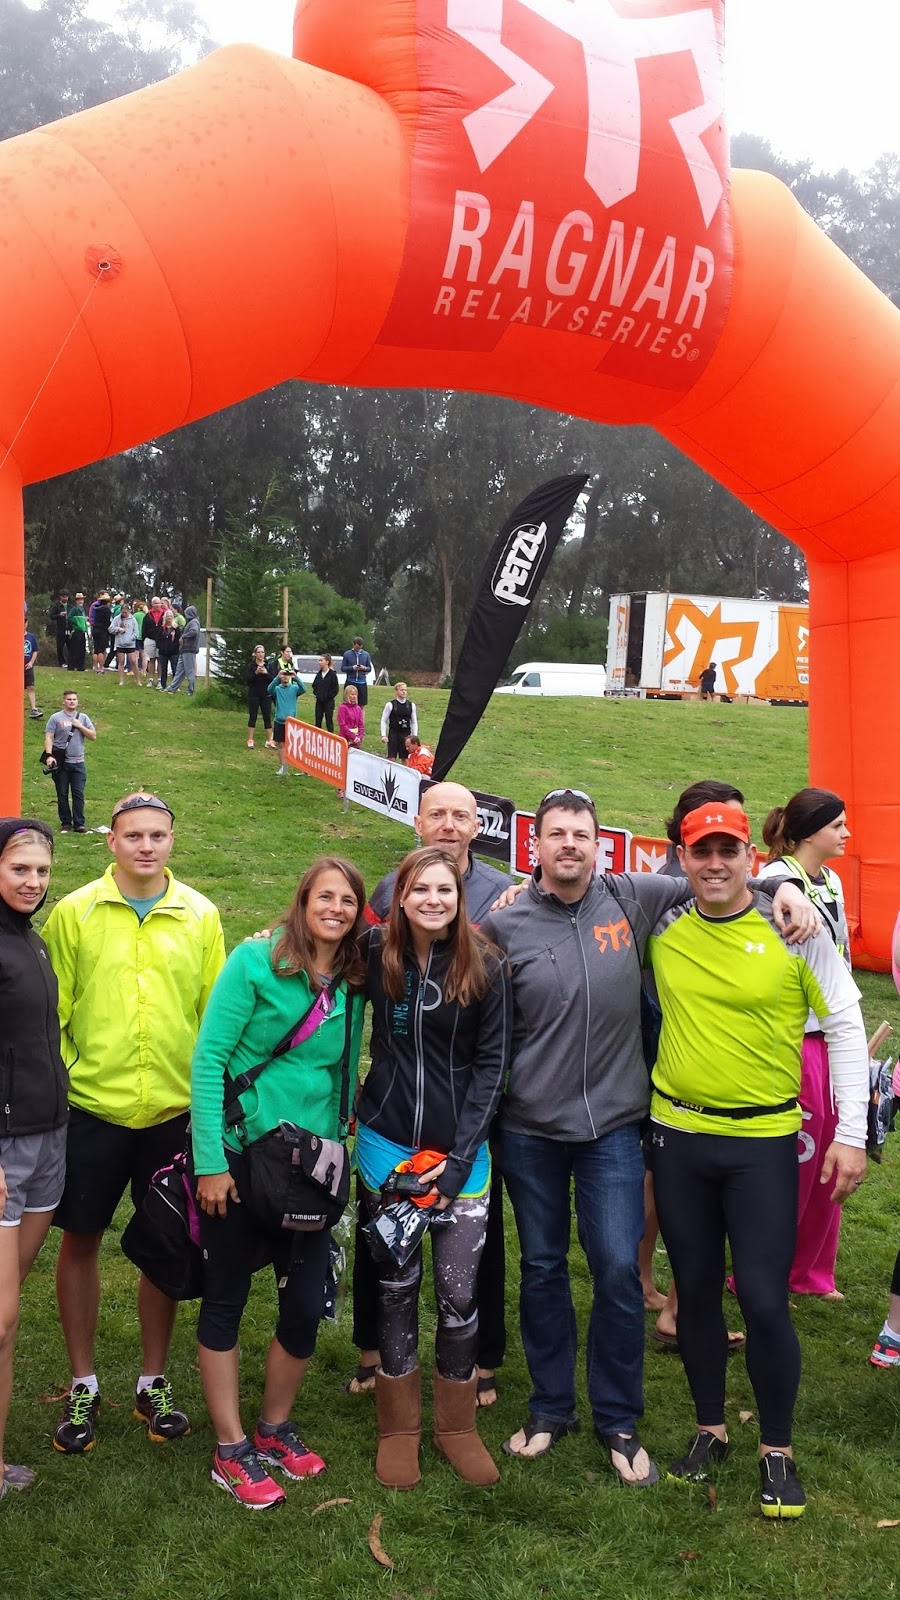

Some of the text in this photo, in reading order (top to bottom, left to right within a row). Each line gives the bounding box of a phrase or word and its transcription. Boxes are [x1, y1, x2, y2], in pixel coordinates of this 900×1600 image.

[442, 189, 715, 330] RAGNAR
[432, 285, 562, 328] RELAY
[494, 521, 548, 606] PETZL
[305, 728, 342, 768] RAGNAR
[354, 782, 385, 803] SWEAT
[476, 806, 510, 840] ETZL
